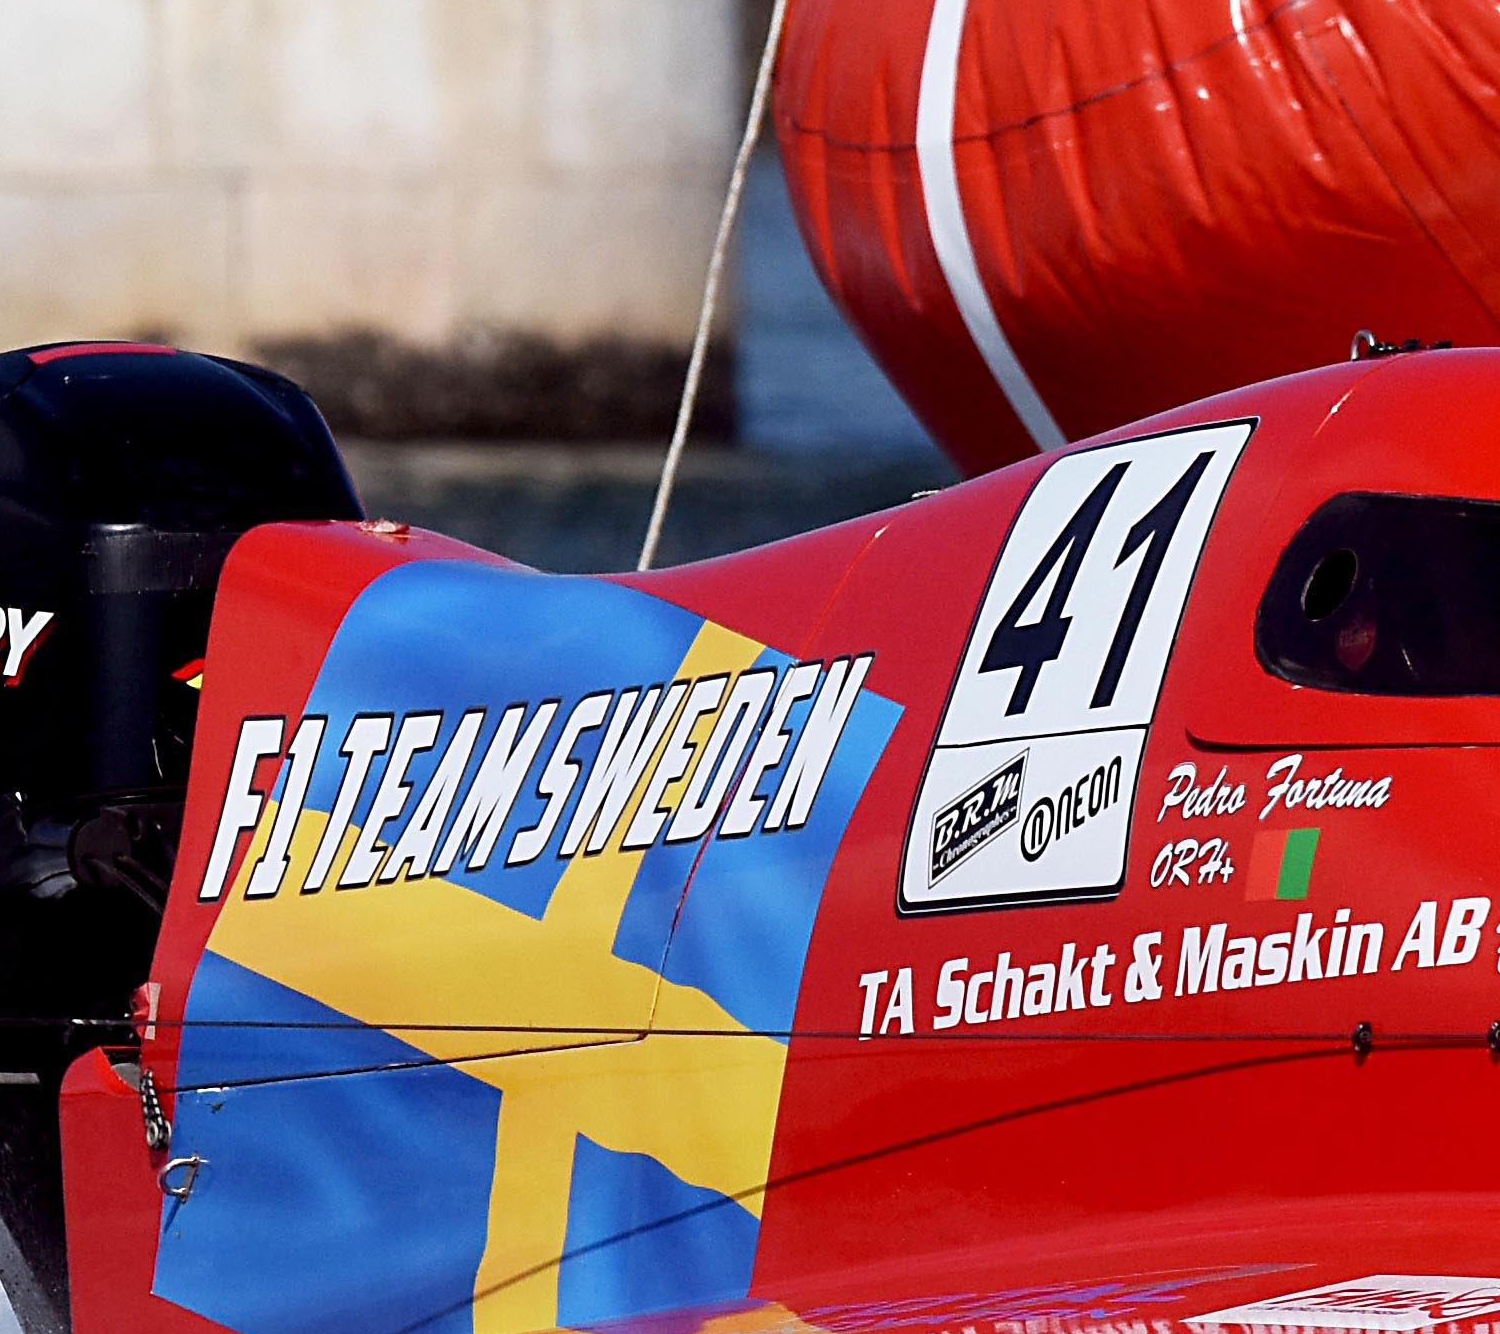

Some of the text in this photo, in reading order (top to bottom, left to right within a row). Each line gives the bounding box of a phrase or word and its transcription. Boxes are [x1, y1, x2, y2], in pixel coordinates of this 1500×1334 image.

[977, 450, 1217, 718] 41
[197, 714, 328, 903] F1
[505, 651, 876, 867] SWEDEN
[1156, 753, 1393, 823] Pedro Fortuna
[858, 967, 915, 1041] TA
[933, 942, 1116, 1030] Schakt
[1124, 931, 1163, 1004] &
[1174, 908, 1384, 997] Maskin
[1392, 896, 1492, 971] AB
